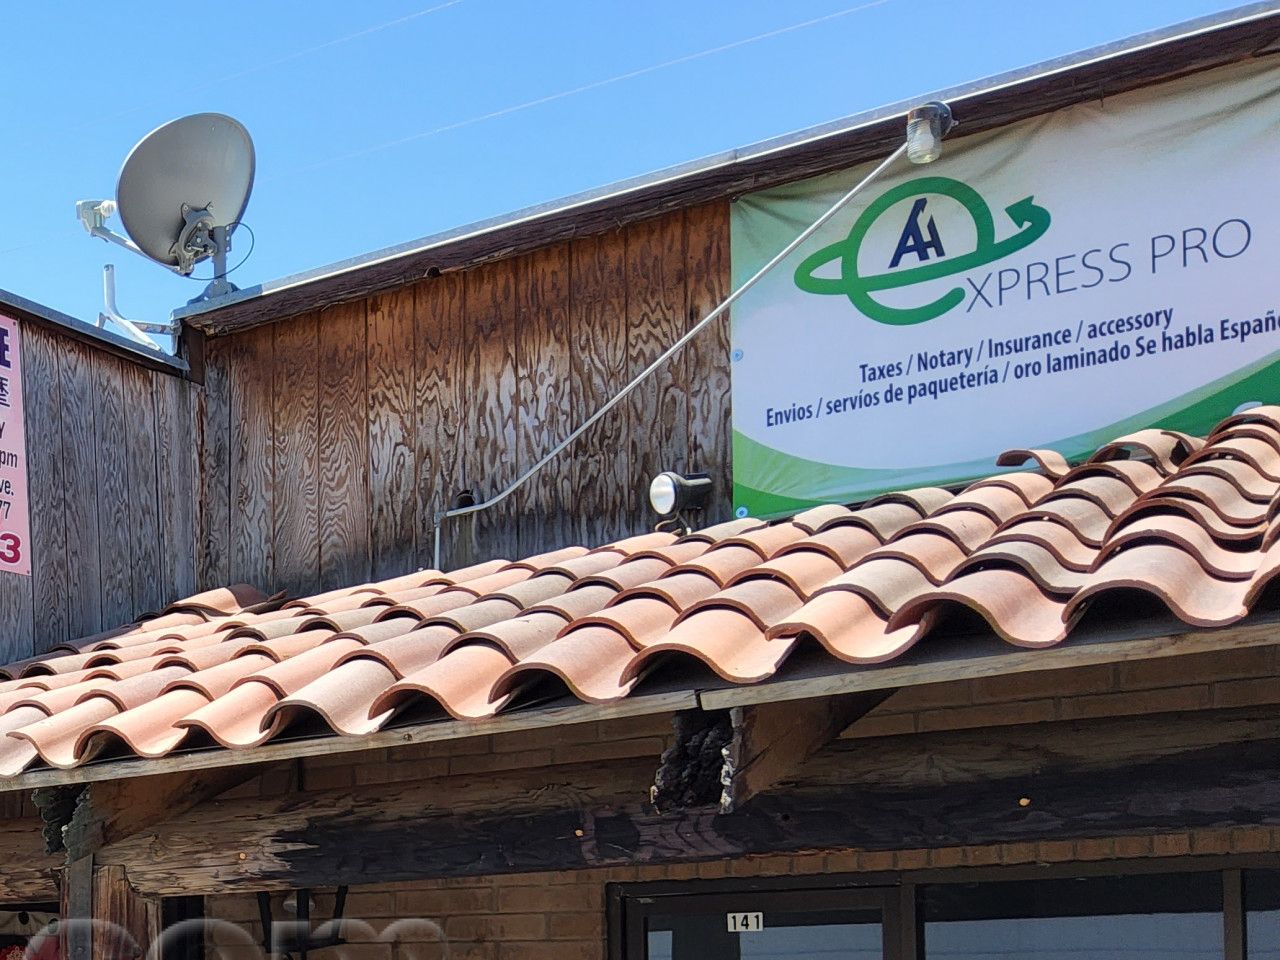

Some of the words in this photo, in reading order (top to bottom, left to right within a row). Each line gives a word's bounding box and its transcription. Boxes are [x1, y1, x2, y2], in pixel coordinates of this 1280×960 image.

[1150, 218, 1251, 274] PRO
[766, 403, 813, 427] Envios
[884, 383, 904, 404] de
[907, 365, 999, 404] paquetería
[1014, 360, 1042, 379] oro
[1046, 341, 1131, 374] laminado
[1135, 336, 1157, 357] Se
[1162, 323, 1215, 352] habla
[1220, 309, 1280, 343] Españ
[859, 361, 903, 383] Taxes
[917, 347, 973, 368] Notary
[988, 328, 1072, 359] Insurance
[1087, 308, 1174, 339] accessory
[731, 914, 760, 931] 141
